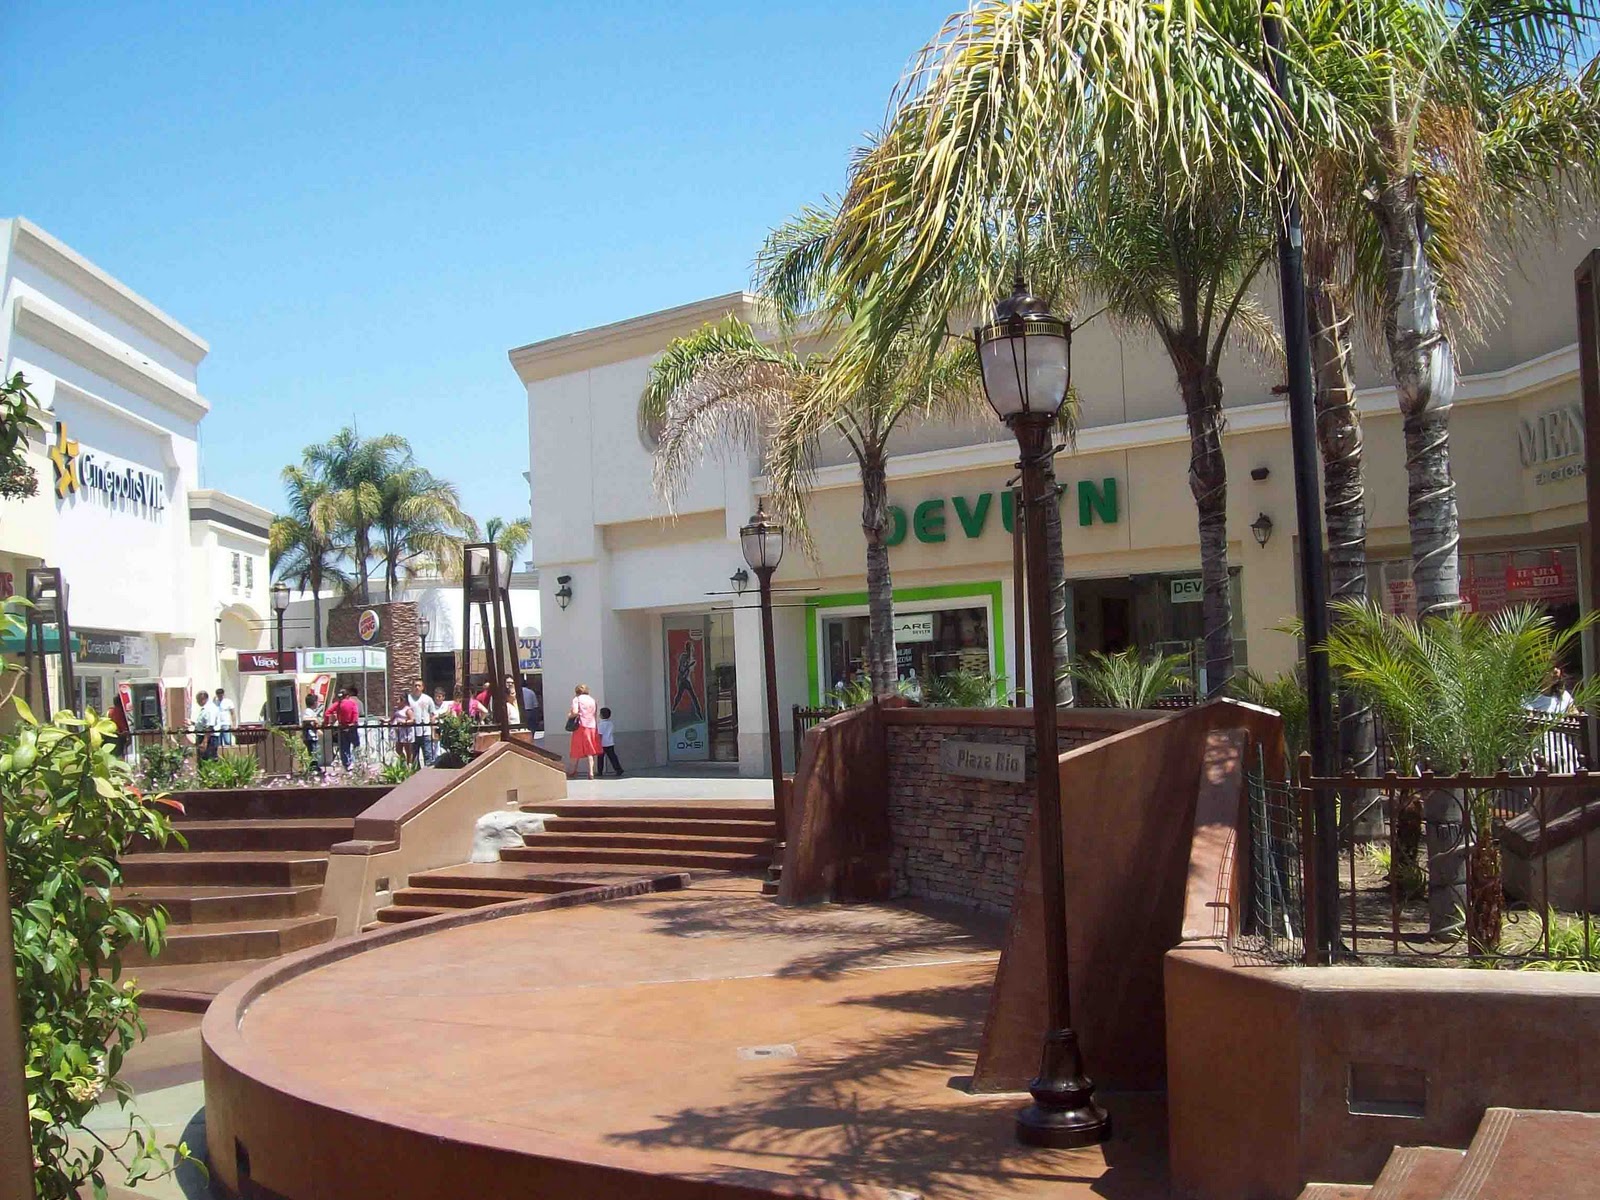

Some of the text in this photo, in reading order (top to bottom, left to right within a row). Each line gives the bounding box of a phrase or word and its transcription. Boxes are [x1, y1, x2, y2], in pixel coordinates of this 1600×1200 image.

[886, 477, 1118, 547] DEVLN
[325, 655, 357, 664] natura
[957, 749, 992, 770] Plaza
